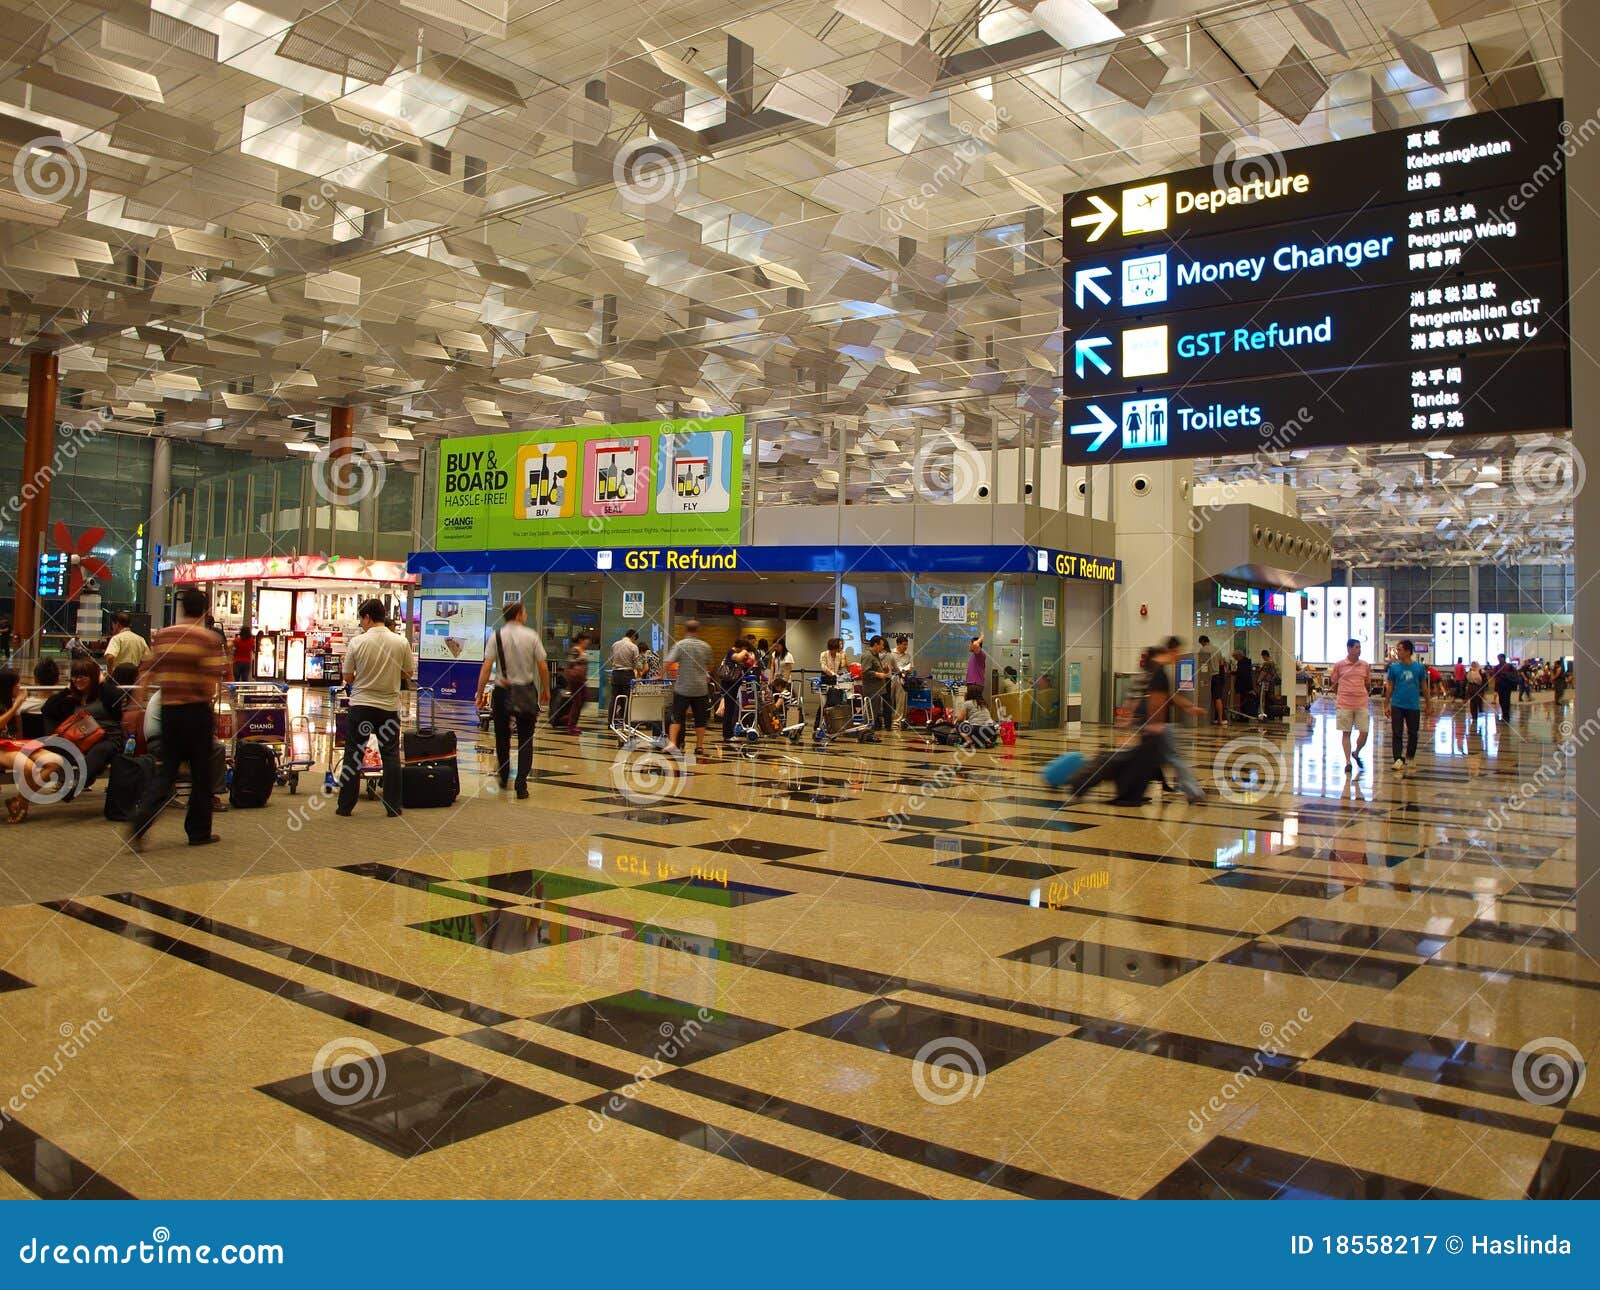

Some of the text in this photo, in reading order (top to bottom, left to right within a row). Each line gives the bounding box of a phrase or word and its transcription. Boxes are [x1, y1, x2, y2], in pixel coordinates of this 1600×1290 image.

[1407, 140, 1511, 169] Keberangkatan
[1175, 174, 1310, 214] Departure
[1408, 221, 1517, 248] Pengurup Wang
[1176, 235, 1394, 287] Money Changer
[1409, 298, 1541, 328] Pengembalian GST
[1176, 315, 1332, 358] GST Refund
[1411, 390, 1460, 408] Tandas
[1176, 403, 1261, 431] Toilets
[447, 450, 497, 472] BUY &
[446, 471, 508, 492] BOARD
[536, 509, 549, 517] BUY
[604, 506, 623, 514] SEAL
[683, 502, 698, 511] FLY
[625, 549, 737, 569] GST Refund
[1055, 554, 1115, 581] GST Refund
[946, 596, 961, 606] TAX
